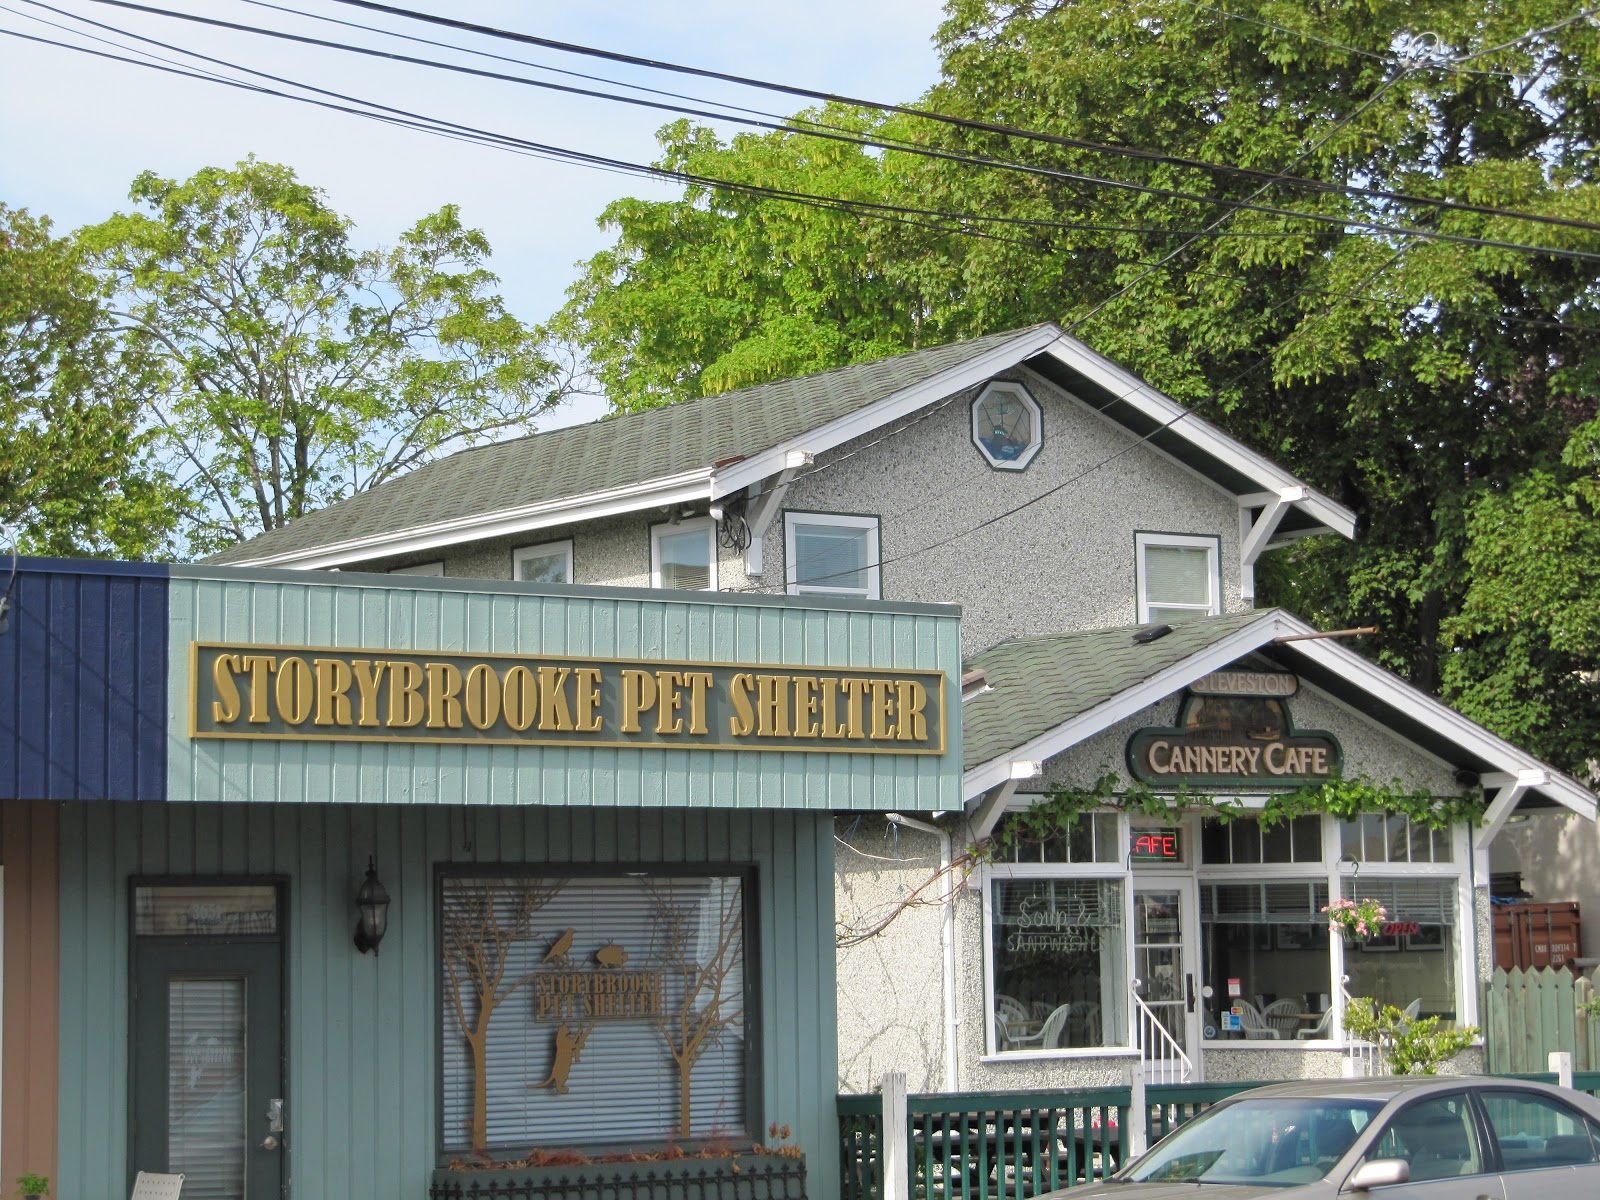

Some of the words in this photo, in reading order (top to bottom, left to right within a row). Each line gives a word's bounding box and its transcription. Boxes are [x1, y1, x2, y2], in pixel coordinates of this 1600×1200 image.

[211, 653, 602, 732] STORYBROOKE
[620, 669, 714, 735] PET
[730, 673, 928, 740] SHELTER
[1149, 741, 1260, 776] CANNERY
[1263, 742, 1328, 775] CAFE
[1130, 835, 1176, 855] AFE
[1017, 901, 1067, 932] Soup
[1383, 922, 1419, 936] OPEN
[539, 973, 661, 995] STORYBROOKE
[539, 994, 574, 1017] PET
[583, 992, 661, 1017] SHELTER
